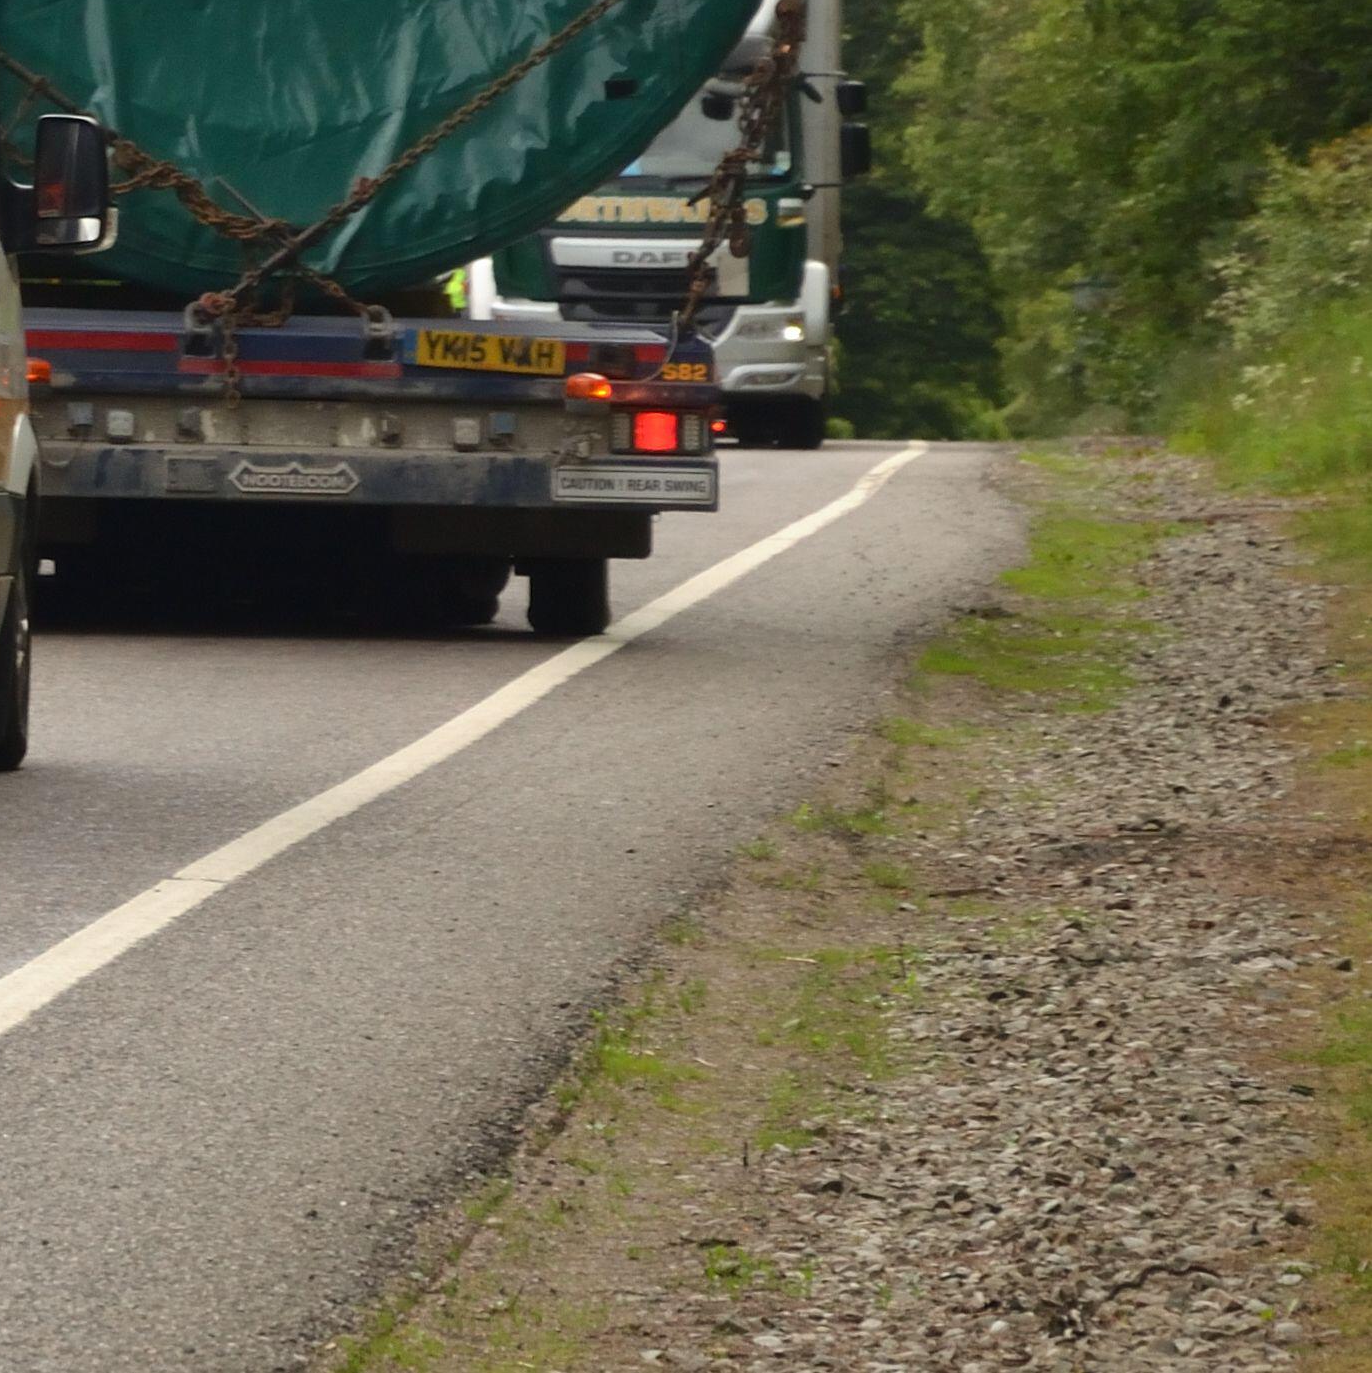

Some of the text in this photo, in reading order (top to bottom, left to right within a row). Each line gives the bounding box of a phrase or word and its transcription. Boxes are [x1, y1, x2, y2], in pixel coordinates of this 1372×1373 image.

[612, 250, 683, 265] DAF
[561, 476, 615, 491] CAUTION
[627, 478, 661, 493] REAR
